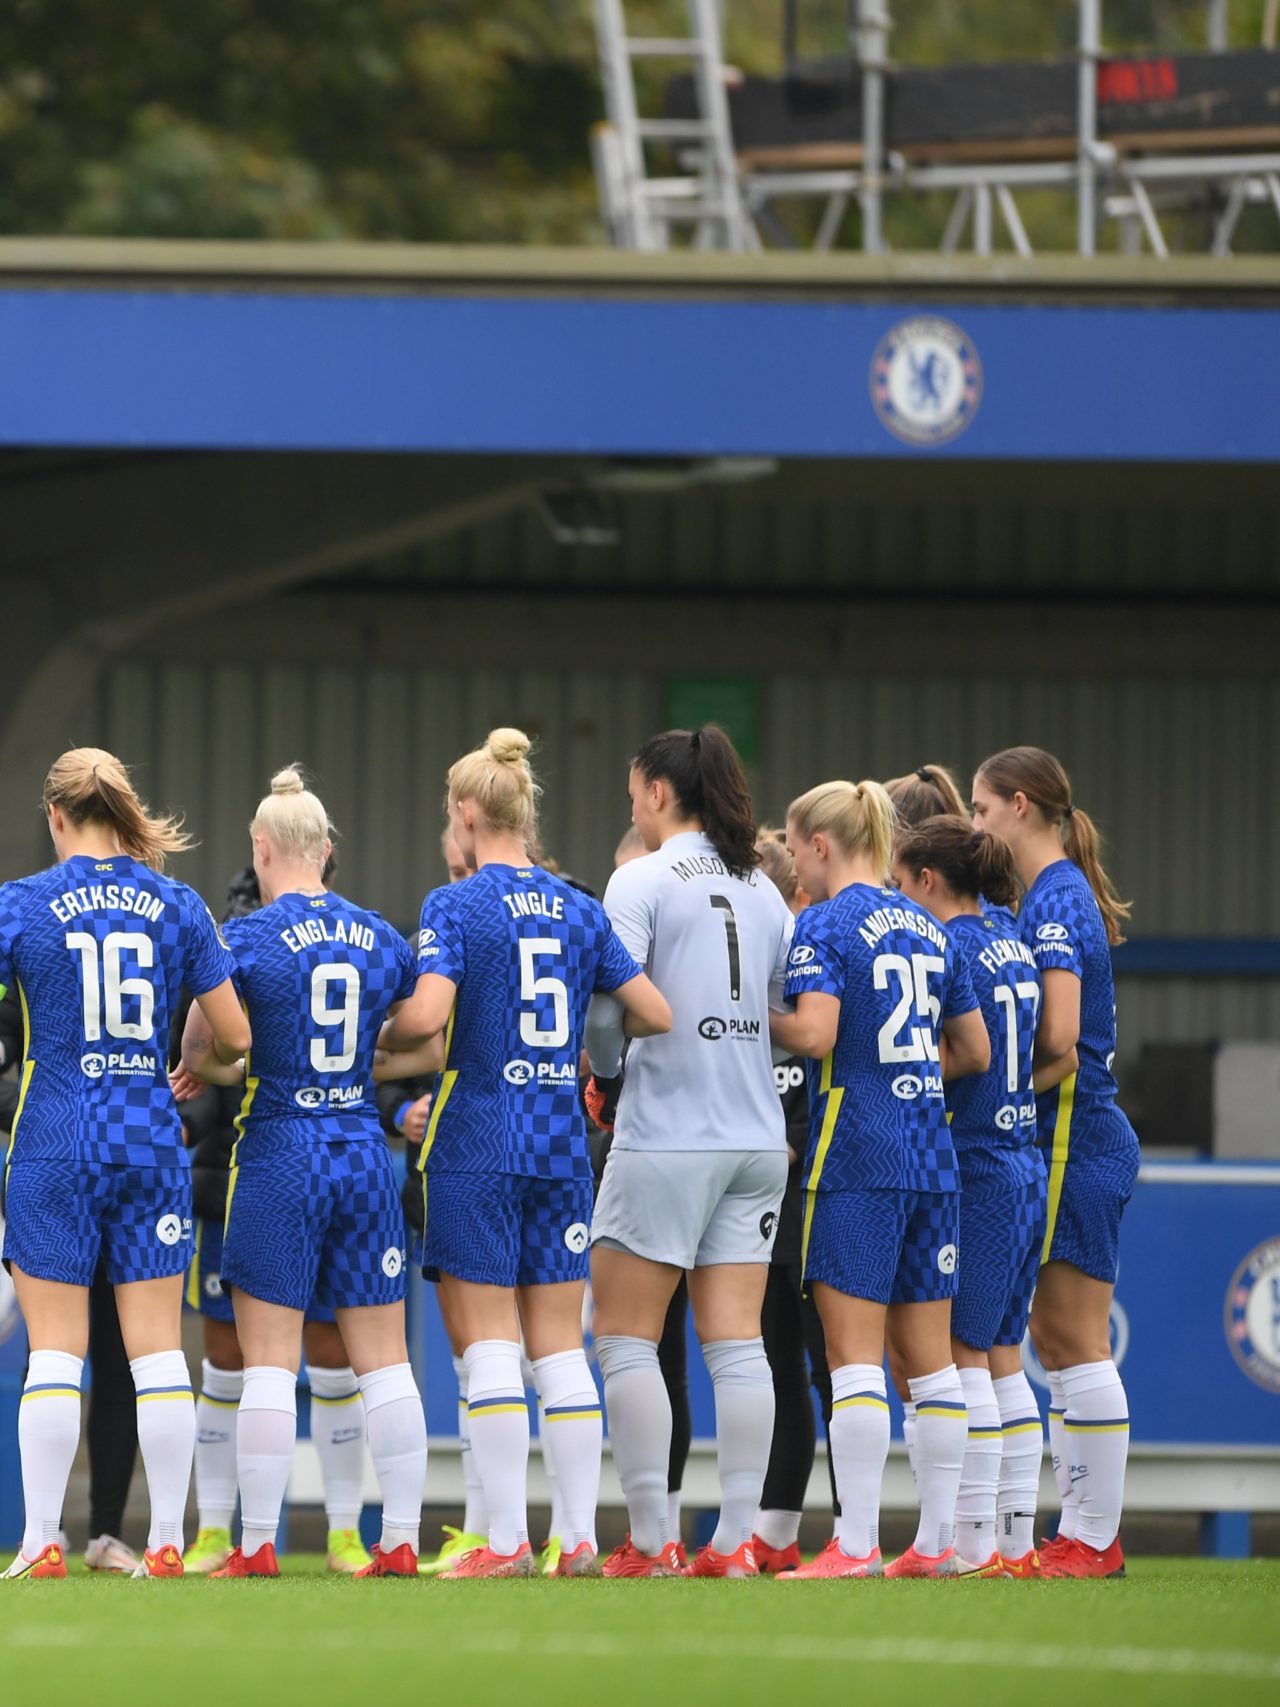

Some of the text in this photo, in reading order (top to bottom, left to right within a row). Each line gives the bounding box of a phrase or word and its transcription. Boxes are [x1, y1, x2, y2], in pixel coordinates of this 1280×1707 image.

[94, 863, 114, 871] CFC
[49, 885, 166, 924] ERIKSSON
[309, 899, 327, 907] CFC
[502, 891, 564, 920] INGLE
[280, 918, 375, 953] ENGLAND
[858, 908, 947, 953] ANDERSSON
[708, 893, 742, 1002] 1
[1032, 941, 1074, 956] HYUNDAI
[65, 931, 155, 1042] 16
[786, 965, 822, 979] YUNDAI
[519, 937, 570, 1047] 5
[310, 963, 361, 1073] 9
[873, 953, 945, 1064] 25
[730, 1019, 760, 1034] PLAN
[994, 981, 1040, 1093] 17
[107, 1053, 156, 1070] PLAN
[107, 1069, 156, 1077] INTERNATIONAL
[328, 1084, 364, 1101] PLAN
